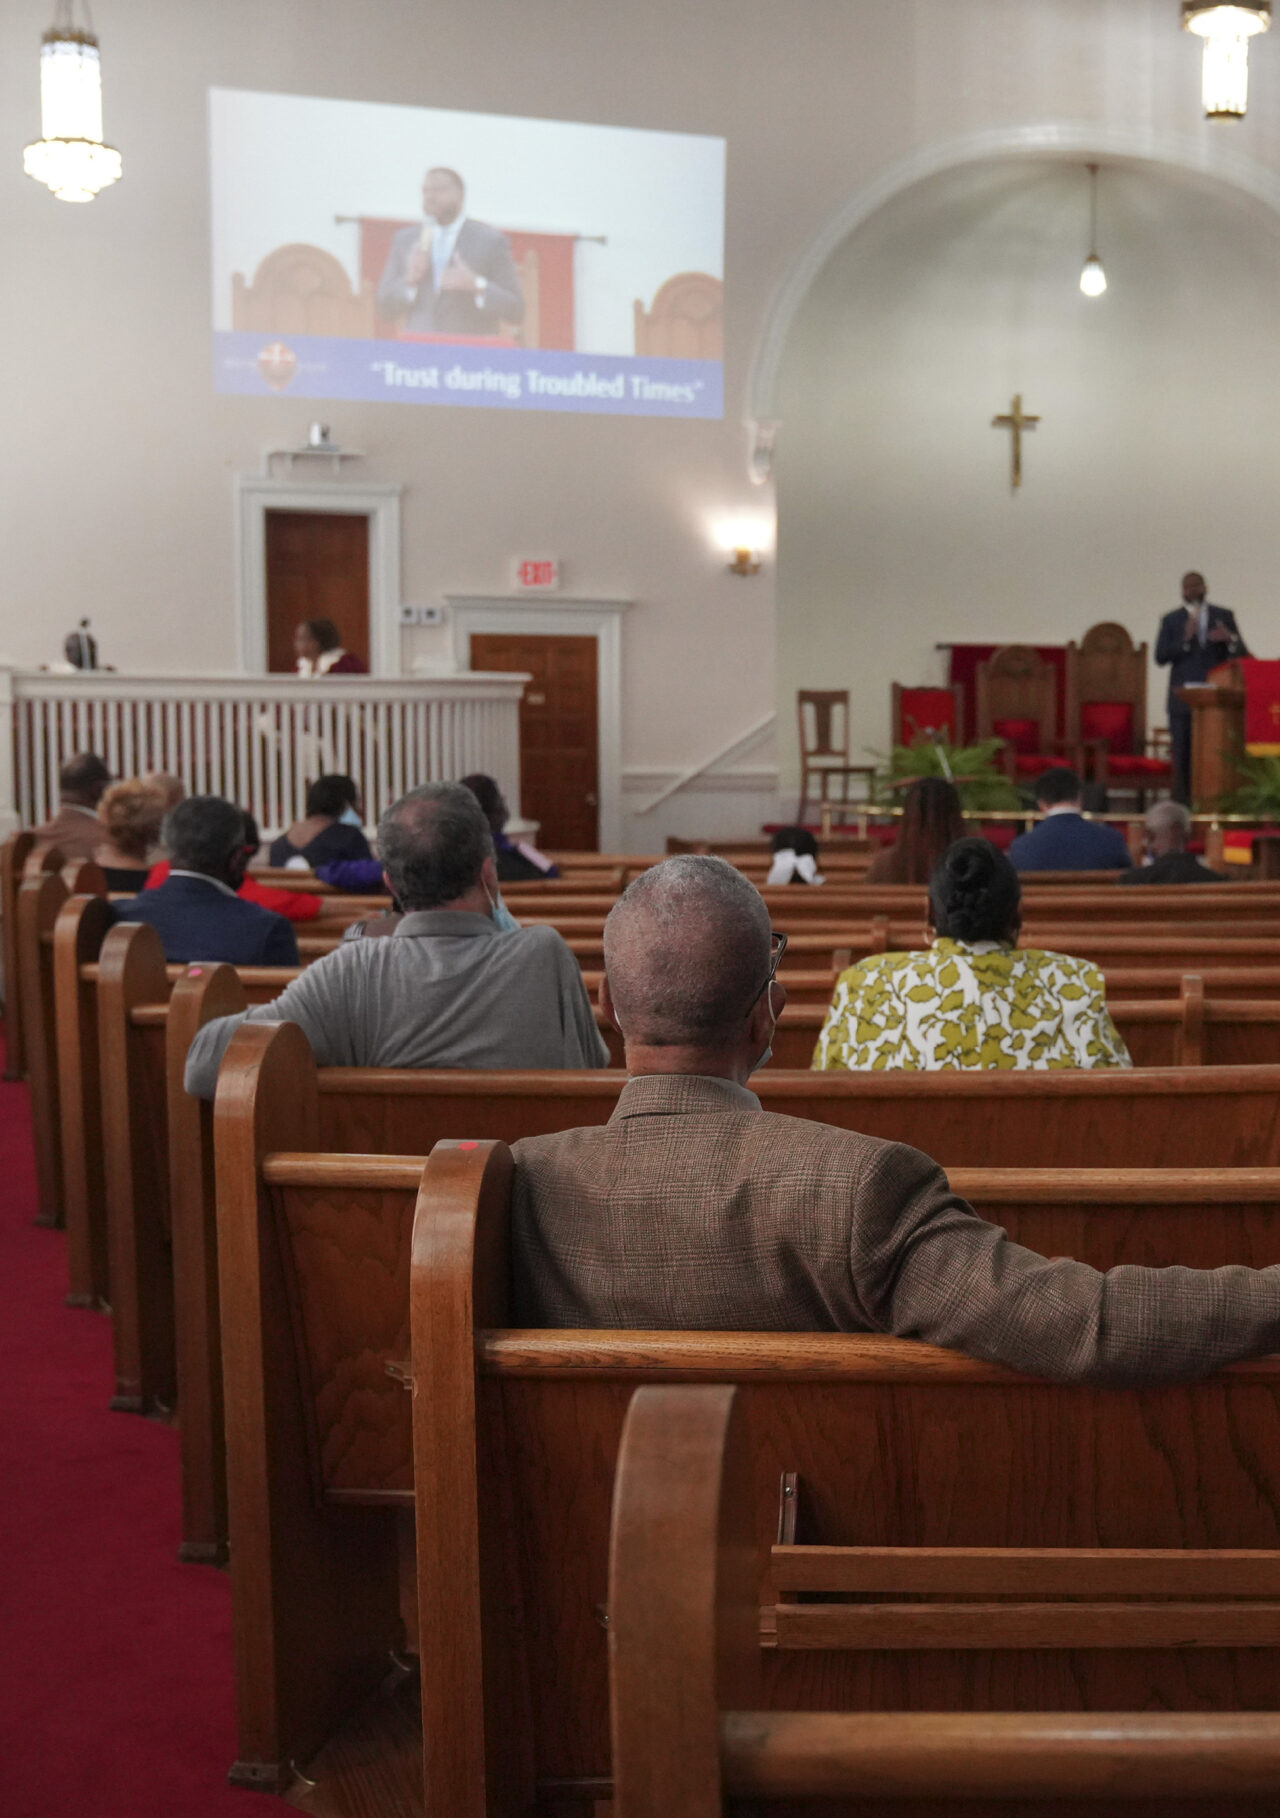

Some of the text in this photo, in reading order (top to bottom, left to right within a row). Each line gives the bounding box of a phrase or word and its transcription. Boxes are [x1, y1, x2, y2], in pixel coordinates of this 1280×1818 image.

[444, 364, 521, 398] during
[527, 369, 624, 399] Troubled
[521, 560, 553, 586] EXIT
